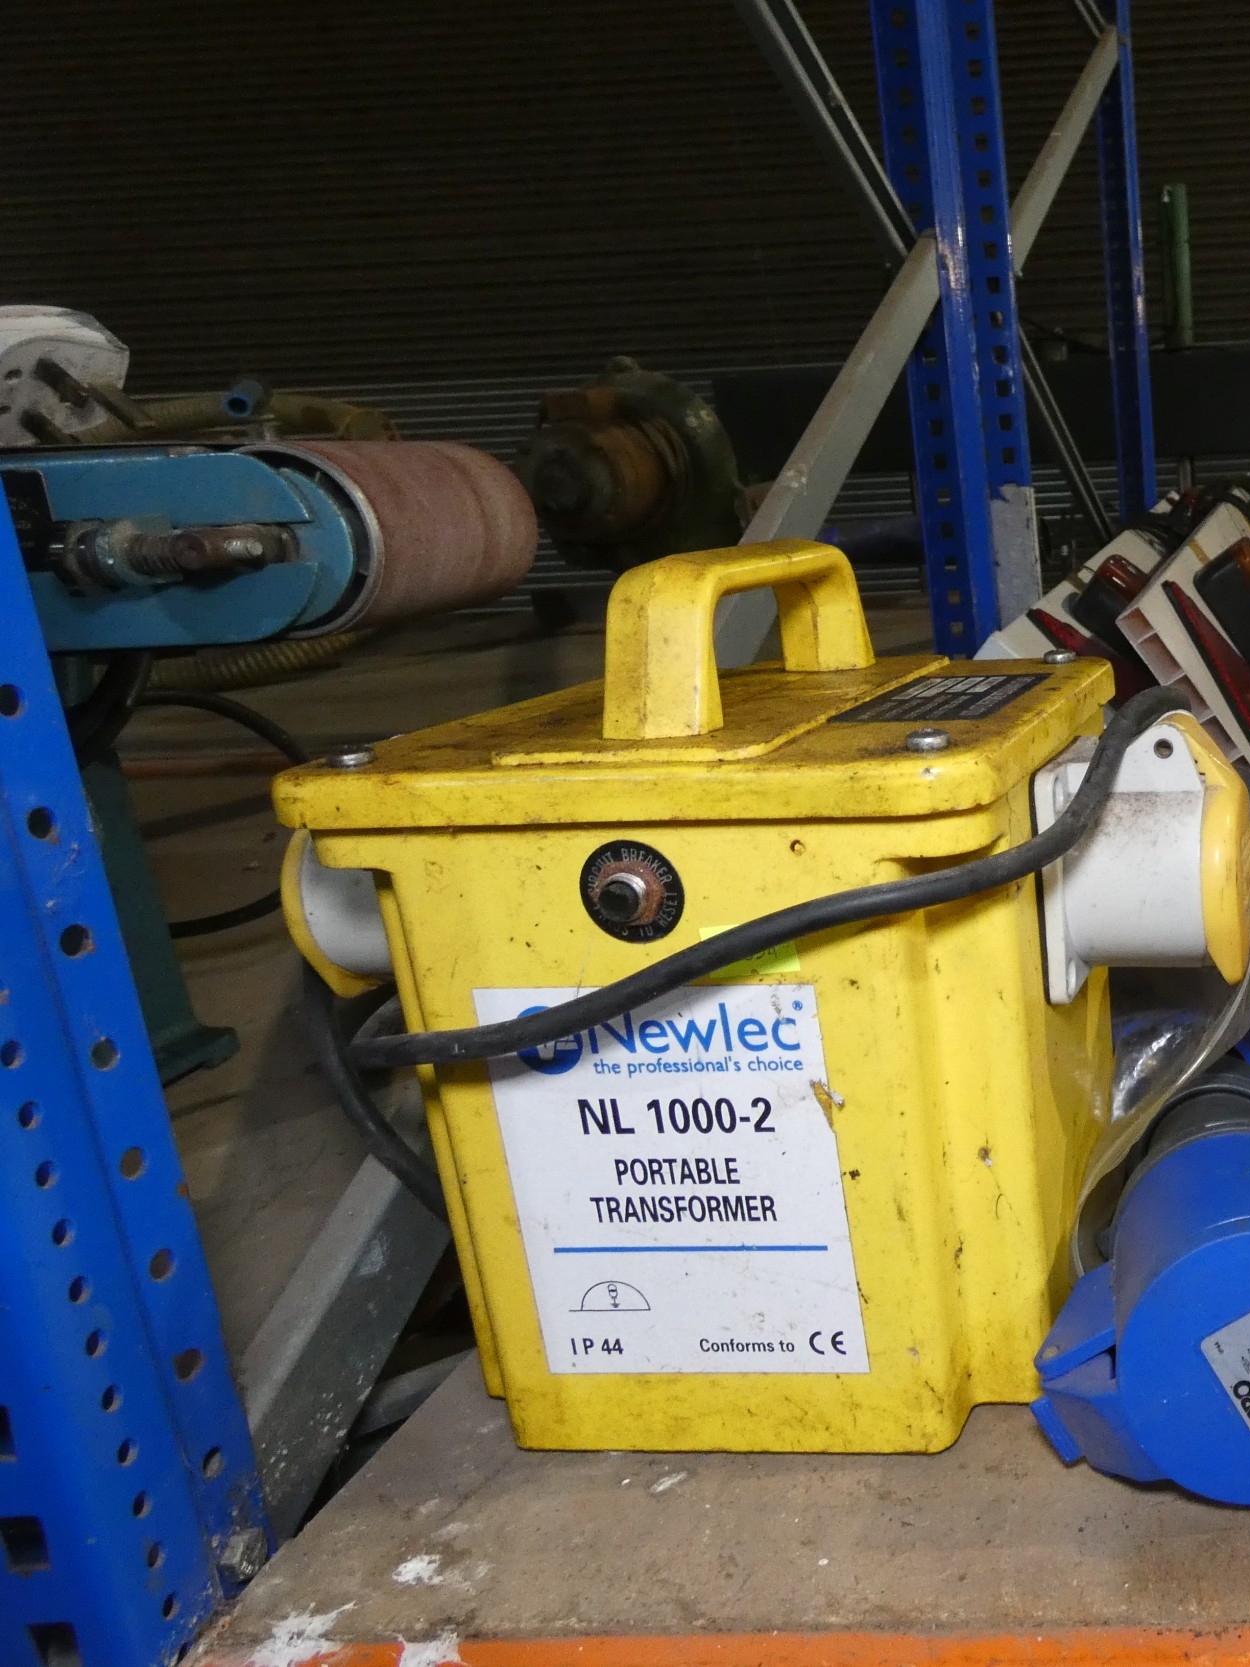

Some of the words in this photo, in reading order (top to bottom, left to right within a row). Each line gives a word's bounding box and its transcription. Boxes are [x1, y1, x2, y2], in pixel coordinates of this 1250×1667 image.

[621, 848, 673, 885] BREAKER
[656, 892, 678, 928] RESET
[588, 1003, 801, 1054] Newlec
[593, 1059, 621, 1075] the
[628, 1056, 742, 1078] professional's
[747, 1056, 804, 1072] choice
[577, 1098, 635, 1135] NL
[646, 1097, 776, 1135] 1000-2
[614, 1157, 741, 1185] PORTABLE
[589, 1195, 778, 1223] TRANSFORMER
[601, 1338, 624, 1355] 44
[699, 1338, 775, 1353] Conforms
[778, 1339, 795, 1353] to
